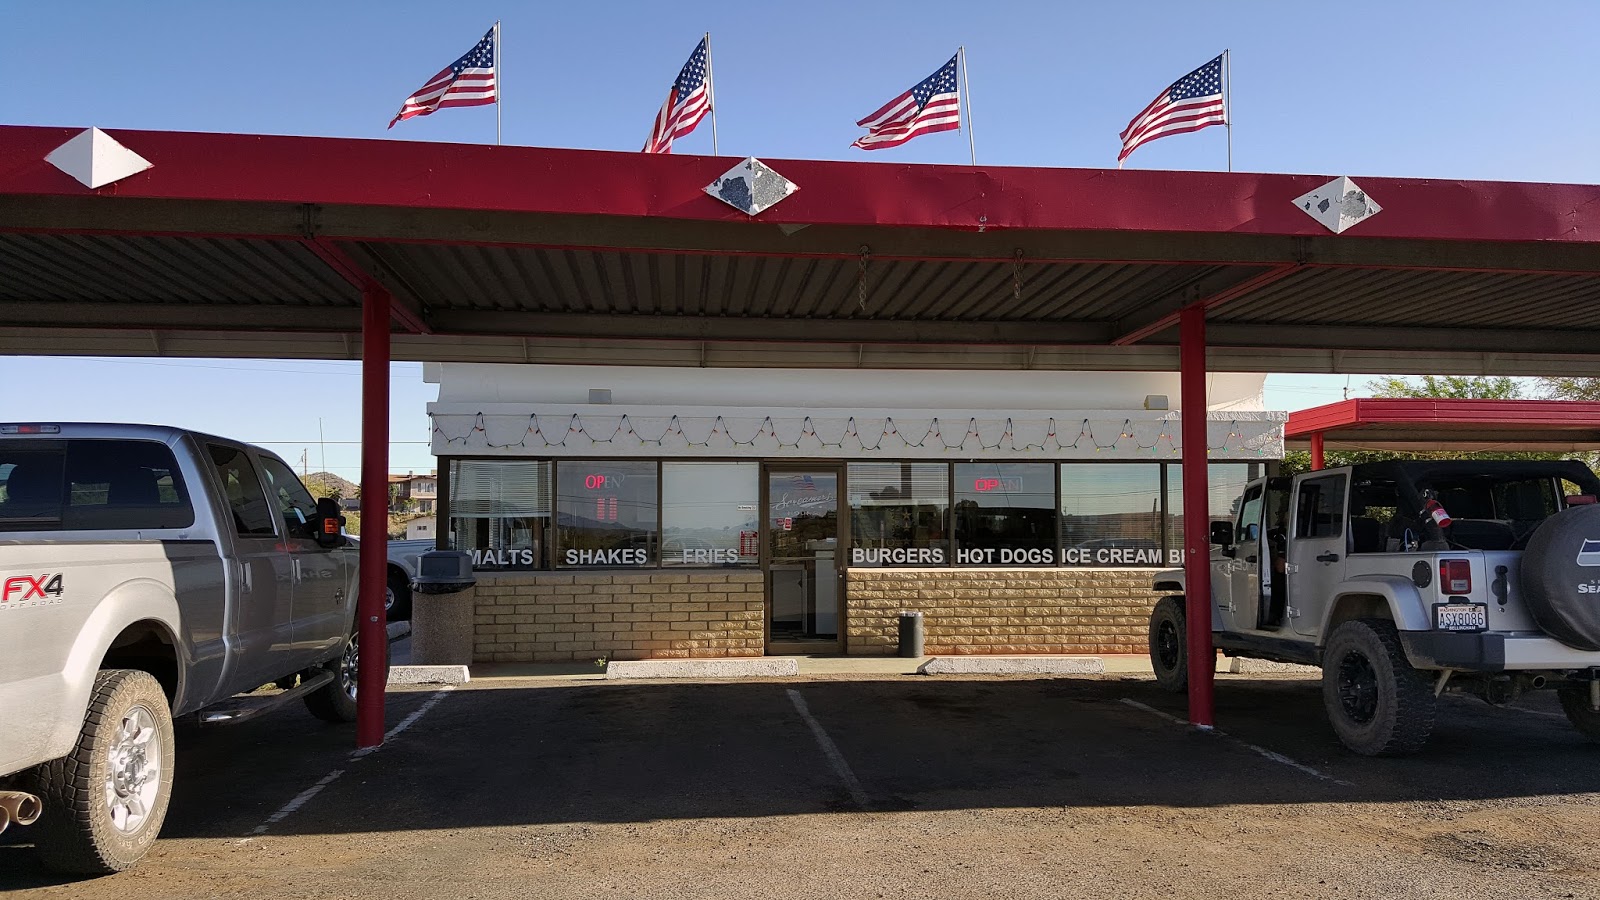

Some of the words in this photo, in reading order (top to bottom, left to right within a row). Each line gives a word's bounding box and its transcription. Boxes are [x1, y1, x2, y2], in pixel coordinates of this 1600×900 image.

[585, 474, 621, 489] OPEN
[466, 549, 533, 565] MALTS
[565, 548, 647, 565] SHAKES
[683, 548, 739, 564] FRIES
[852, 548, 944, 563] BURGERS
[957, 548, 995, 563] HOT
[1000, 548, 1054, 563] DOGS
[1061, 548, 1091, 563] ICE
[1097, 548, 1162, 563] CREAM
[1, 572, 64, 602] FX4
[1439, 612, 1484, 625] ASX8086
